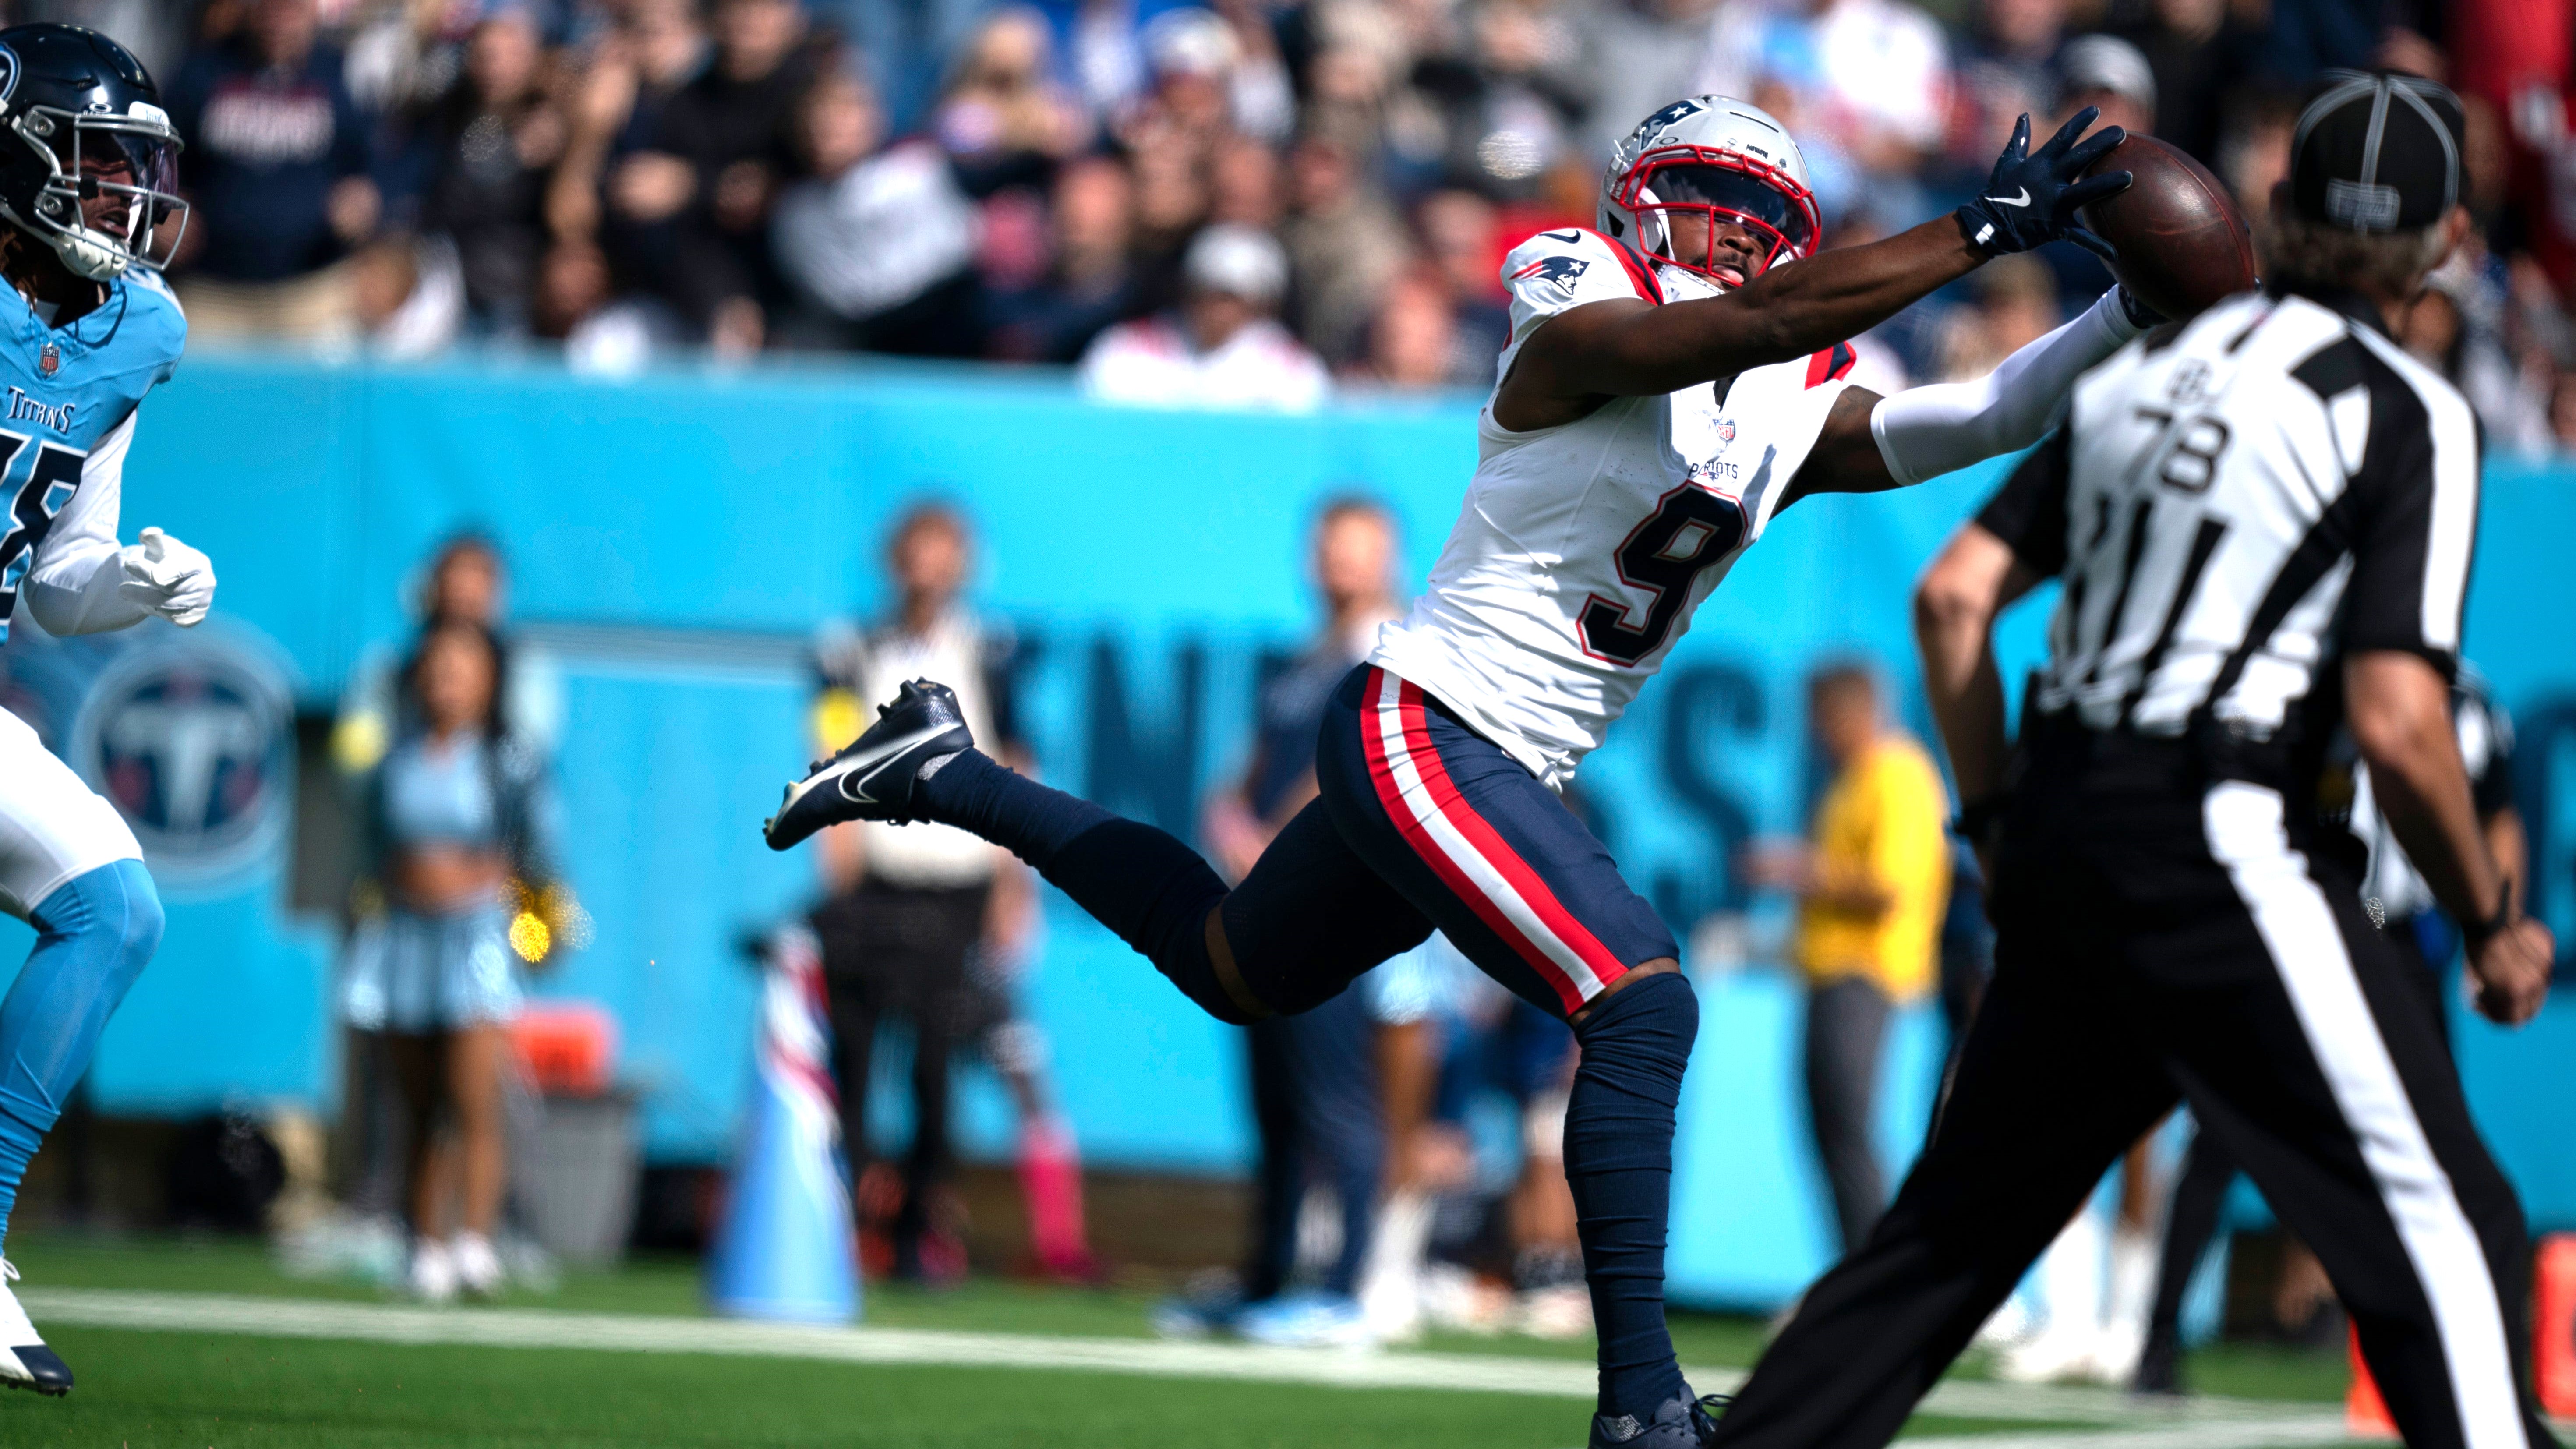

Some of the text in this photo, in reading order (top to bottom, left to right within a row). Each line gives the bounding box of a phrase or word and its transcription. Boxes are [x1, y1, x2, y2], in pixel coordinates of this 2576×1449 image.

[7, 385, 75, 434] TITANS
[1717, 426, 1735, 439] NFL
[1688, 461, 1739, 480] PRIOTS
[2121, 404, 2231, 494] 78
[1575, 479, 1749, 668] 9
